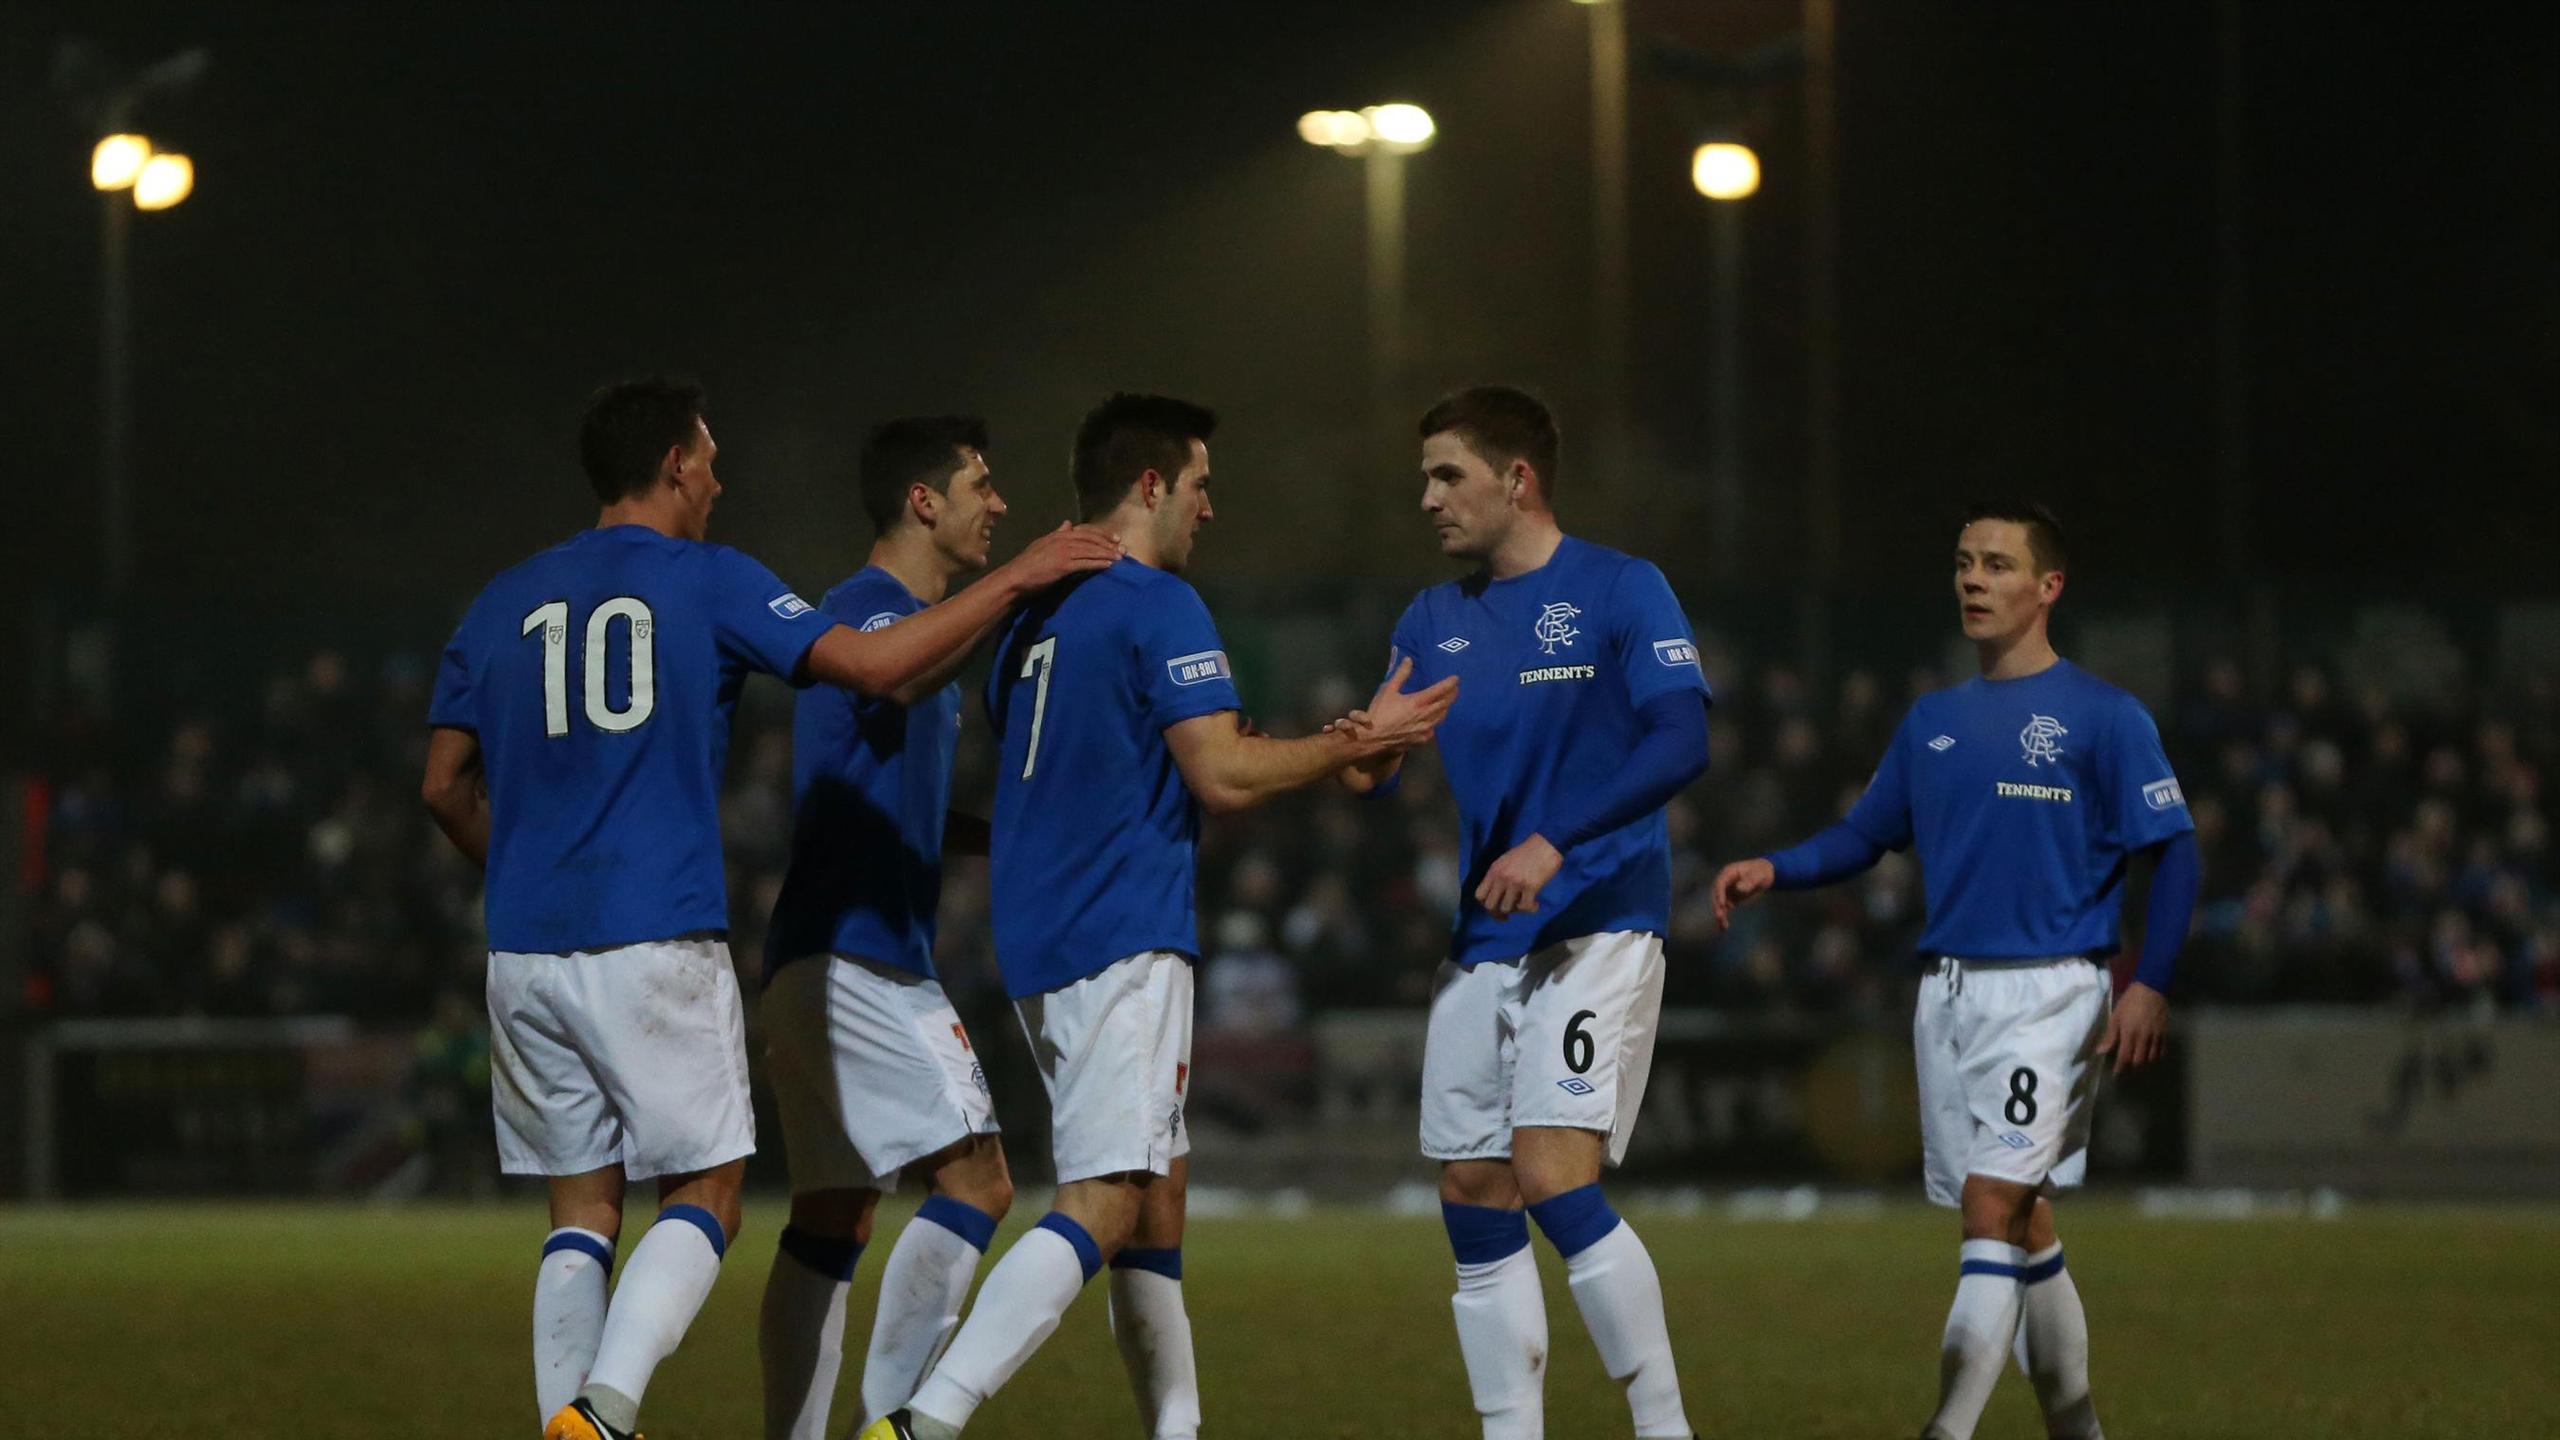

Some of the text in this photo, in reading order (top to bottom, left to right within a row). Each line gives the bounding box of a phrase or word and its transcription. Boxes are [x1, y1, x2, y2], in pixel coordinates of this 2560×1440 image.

[521, 597, 654, 737] 10
[1519, 664, 1595, 685] TENNENT'S
[1020, 636, 1056, 783] 7
[1996, 781, 2073, 803] TENNENT'S
[1564, 1010, 1596, 1074] 6
[2005, 1067, 2037, 1126] 8
